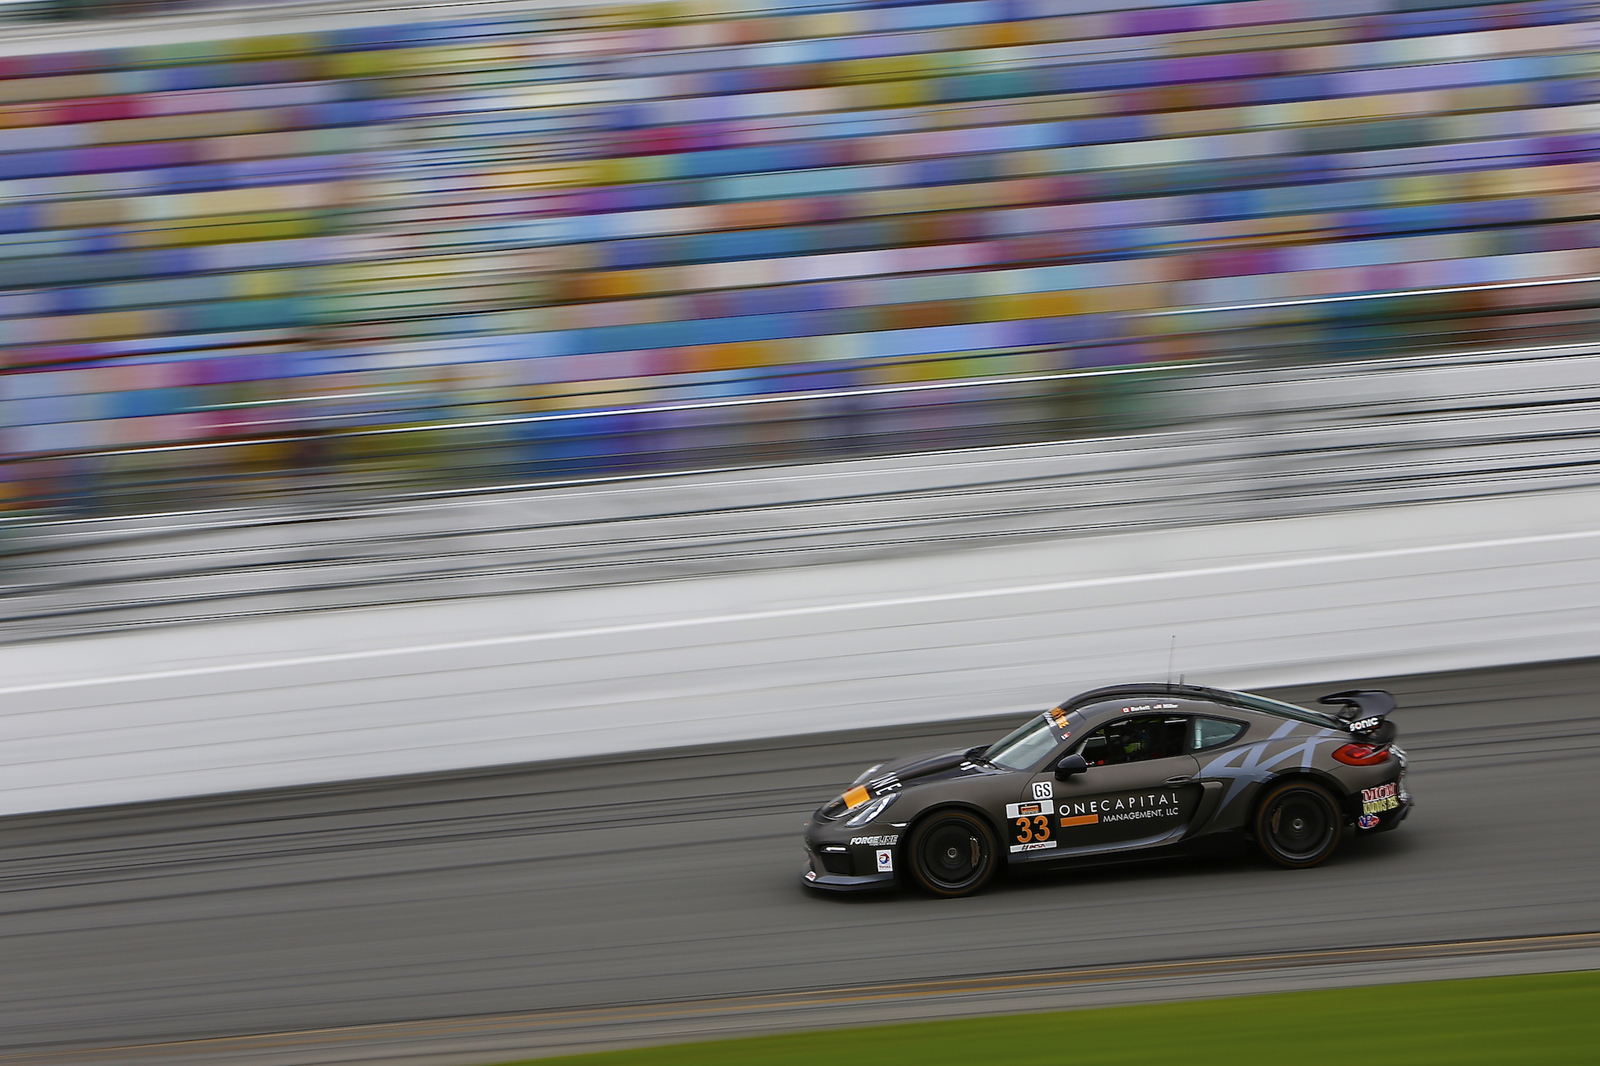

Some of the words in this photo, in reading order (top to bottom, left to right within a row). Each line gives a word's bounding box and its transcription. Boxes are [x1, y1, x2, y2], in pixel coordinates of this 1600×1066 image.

[1034, 783, 1051, 798] GS
[1361, 783, 1397, 802] MOM
[1102, 809, 1164, 823] MANAGEMENT,
[1166, 807, 1179, 816] LLC
[1359, 813, 1373, 828] VP
[1016, 815, 1050, 843] 33
[850, 835, 898, 846] FORGELINE
